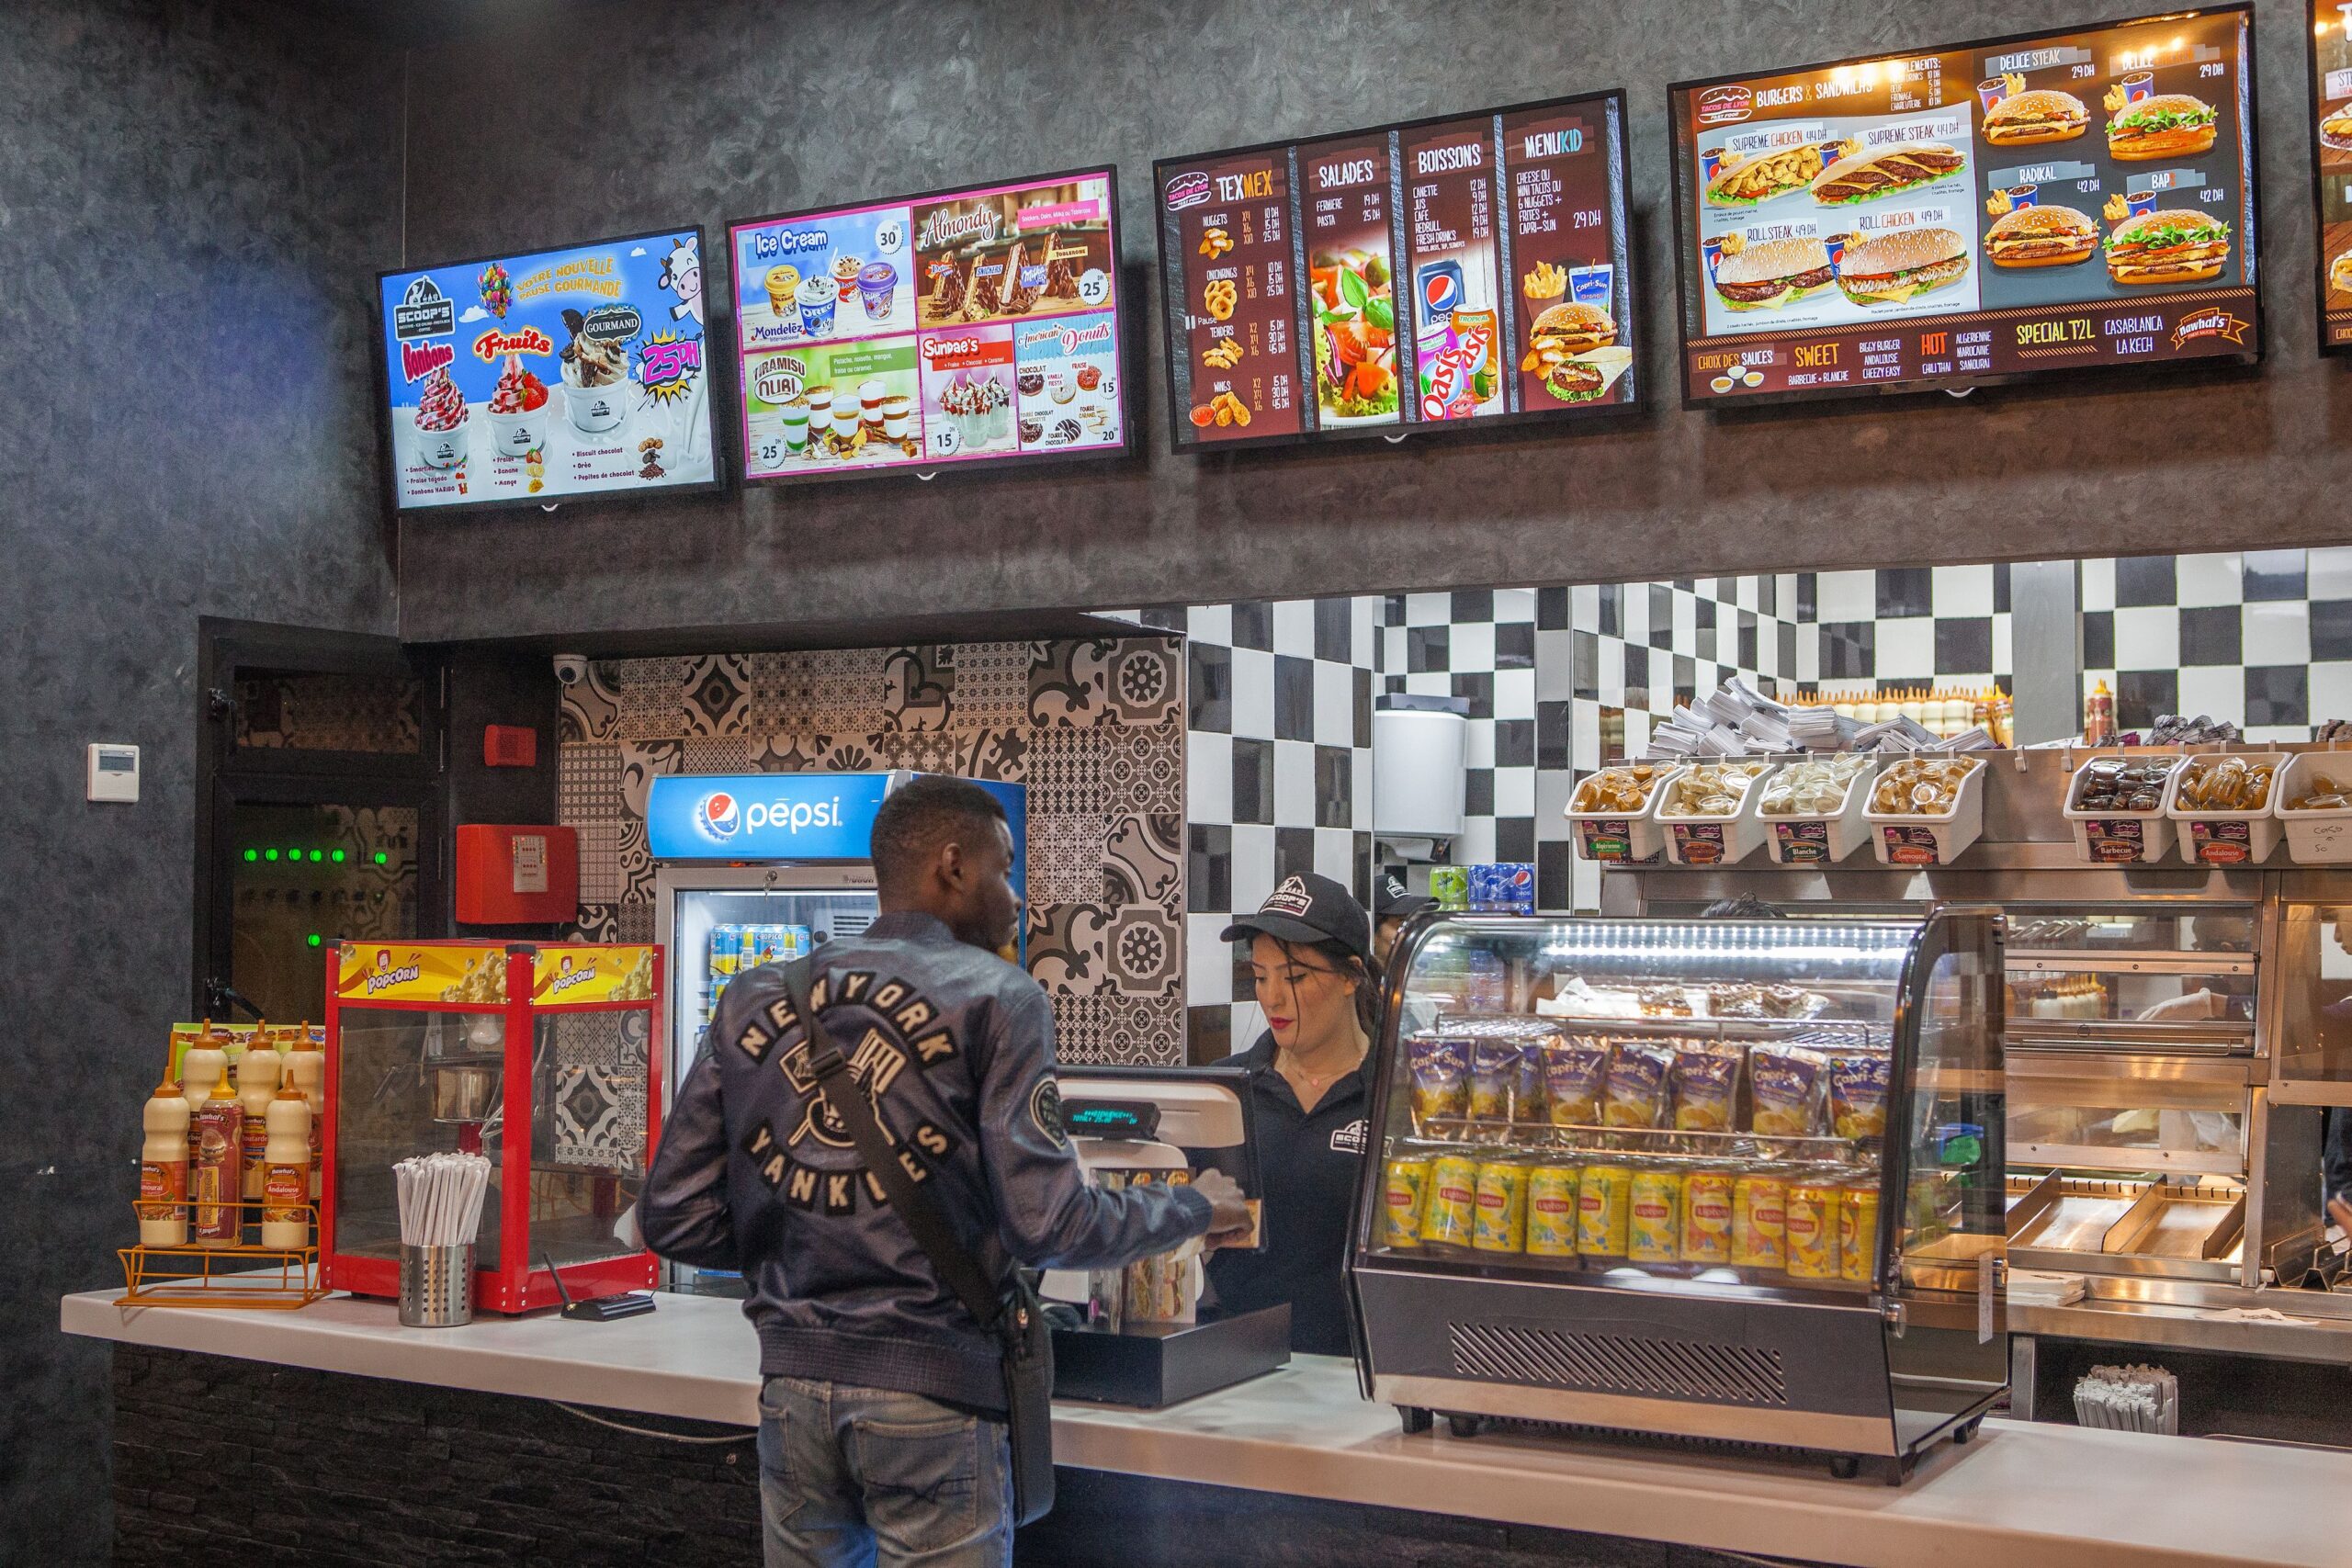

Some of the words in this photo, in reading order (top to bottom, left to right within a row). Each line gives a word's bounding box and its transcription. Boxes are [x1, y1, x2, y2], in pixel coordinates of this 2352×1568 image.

[2000, 53, 2030, 72] DELICE
[2032, 50, 2060, 66] STEAK
[2071, 66, 2084, 79] 29
[2199, 65, 2211, 78] 29
[1757, 86, 1803, 107] BURGERS
[1806, 86, 1812, 100] &
[1525, 129, 1582, 158] MENUKID
[1733, 134, 1769, 151] SUPREME
[1771, 130, 1803, 146] CHICKEN
[1869, 128, 1906, 145] SUPREME
[1909, 125, 1934, 141] STEAK
[1419, 143, 1481, 174] BOISSONS
[1319, 160, 1374, 187] SALADES
[1517, 170, 1540, 184] CHEESE
[1542, 169, 1550, 181] OU
[2019, 165, 2056, 184] RADIKAL
[1169, 191, 1185, 201] TACOS
[1194, 183, 1208, 192] LYON
[1216, 170, 1272, 202] TEXMEX
[1413, 185, 1438, 198] CANETTE
[1470, 179, 1476, 191] 12
[1518, 185, 1531, 197] MINI
[1532, 182, 1551, 195] TACOS
[1553, 181, 1561, 193] OU
[2077, 182, 2087, 193] 42
[1364, 195, 1370, 206] 19
[1414, 199, 1426, 209] JUS
[1473, 192, 1476, 202] 9
[1519, 198, 1523, 209] 6
[1524, 195, 1553, 208] NUGGETS
[2200, 190, 2211, 202] 42
[2213, 188, 2223, 201] DH
[1317, 215, 1335, 227] PASTA
[1363, 209, 1371, 221] 25
[1373, 209, 1380, 220] DH
[1472, 204, 1477, 215] 12
[1520, 209, 1540, 222] FRITES
[922, 204, 1001, 246] Almondy
[1203, 214, 1227, 227] NUGGETS
[1416, 220, 1441, 233] REDBULL
[1472, 216, 1479, 227] 19
[1573, 212, 1587, 228] 29
[1589, 209, 1600, 226] DH
[1860, 216, 1881, 231] ROLL
[1882, 211, 1915, 228] CHICKEN
[1921, 210, 1931, 221] 49
[755, 233, 778, 254] Ice
[781, 230, 828, 251] Cream
[881, 232, 896, 245] 30
[1263, 231, 1272, 243] 25
[1417, 233, 1434, 245] FRESH
[1436, 231, 1456, 243] DRINKS
[1473, 228, 1479, 239] 19
[1747, 228, 1767, 242] ROLL
[1769, 225, 1792, 240] STEAK
[1796, 225, 1805, 235] 49
[1056, 248, 1086, 257] TOBLERONE
[515, 270, 551, 291] VOTRE
[556, 257, 614, 276] NOUVELLE
[978, 266, 1001, 275] SNICKERS
[518, 285, 550, 300] PAUSE
[555, 278, 622, 298] GOURMANDE
[1084, 283, 1100, 296] 25
[1267, 287, 1275, 297] 25
[398, 307, 450, 323] SCOOP'S
[803, 304, 832, 316] OREO
[587, 319, 638, 333] GOURMAND
[1210, 325, 1234, 338] TENDERS
[2017, 321, 2068, 345] SPECIAL
[2069, 319, 2096, 340] T2L
[2105, 316, 2163, 335] CASABLANCA
[476, 330, 549, 358] Fruits
[1018, 331, 1058, 349] American
[1062, 323, 1111, 355] Donuts
[1860, 342, 1876, 353] BIGGY
[1877, 339, 1900, 350] BURGER
[1921, 332, 1948, 355] HOT
[2117, 339, 2127, 354] LA
[2130, 337, 2153, 353] KECH
[403, 343, 453, 381] Bonbons
[1698, 355, 1721, 370] CHOIX
[1723, 354, 1739, 367] DES
[1741, 350, 1773, 366] SAUCES
[1794, 343, 1839, 367] SWEET
[1864, 353, 1898, 366] ANDALOUSE
[754, 357, 805, 379] TIRAMISU
[1019, 366, 1046, 374] CHOCOLAT
[1862, 367, 1883, 378] CHEEZY
[1885, 366, 1900, 377] EASY
[1214, 380, 1231, 392] WINGS
[1422, 346, 1463, 421] Oasis
[1789, 374, 1817, 385] BARBECUE
[1823, 371, 1849, 382] BLANCHE
[1102, 382, 1114, 393] 15
[937, 434, 952, 446] 15
[1103, 431, 1114, 440] 20
[763, 446, 776, 458] 25
[747, 796, 840, 833] pepsi
[368, 965, 419, 994] POPCORN
[553, 967, 595, 994] POPCORN
[1538, 1201, 1567, 1213] Lipton
[1636, 1206, 1667, 1217] Lipton
[1696, 1207, 1729, 1218] Lipton
